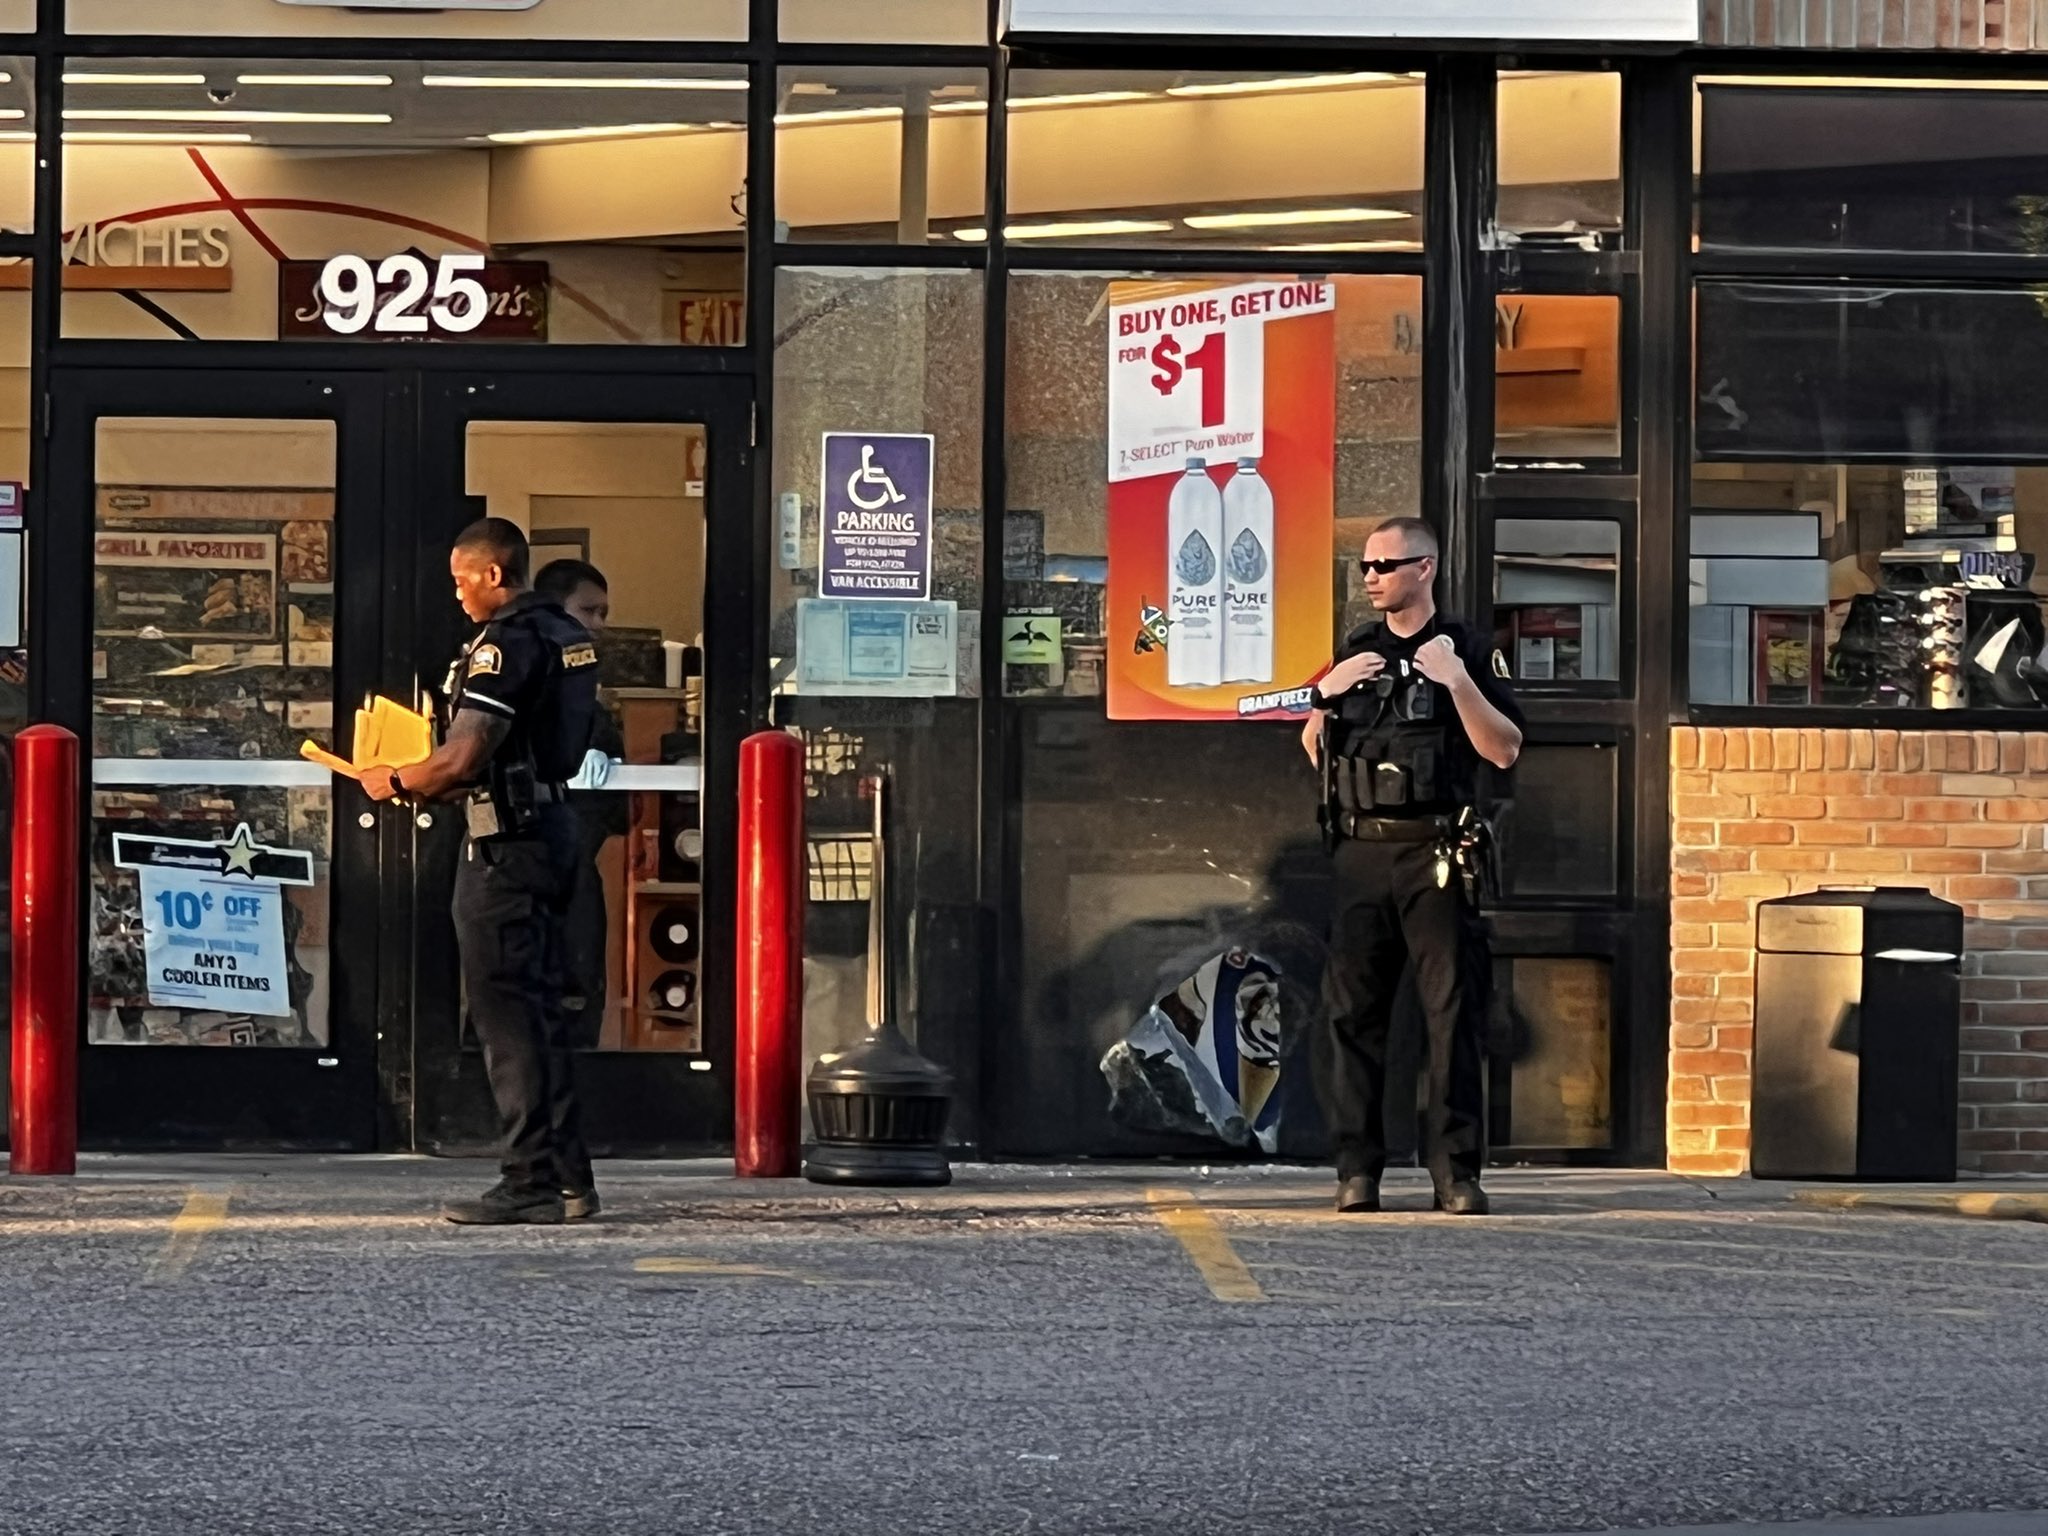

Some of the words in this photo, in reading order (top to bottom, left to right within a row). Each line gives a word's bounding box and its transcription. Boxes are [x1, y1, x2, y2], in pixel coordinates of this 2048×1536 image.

[319, 253, 488, 334] 925
[1119, 307, 1166, 337] BUY
[1170, 299, 1226, 326] ONE,
[1231, 289, 1275, 318] GET
[1279, 281, 1327, 309] ONE
[679, 300, 744, 345] EXIT
[1118, 346, 1147, 363] FOR
[1151, 332, 1226, 428] $1
[837, 511, 915, 531] PARKING
[830, 575, 854, 588] VAN
[856, 576, 920, 590] ACCESSIBLE
[1172, 594, 1217, 607] PURE
[1224, 592, 1268, 605] PURE
[223, 895, 262, 918] OFF
[194, 953, 225, 970] ANY
[227, 955, 237, 971] 3
[162, 967, 222, 987] COOLER
[223, 973, 271, 992] ITEMS
